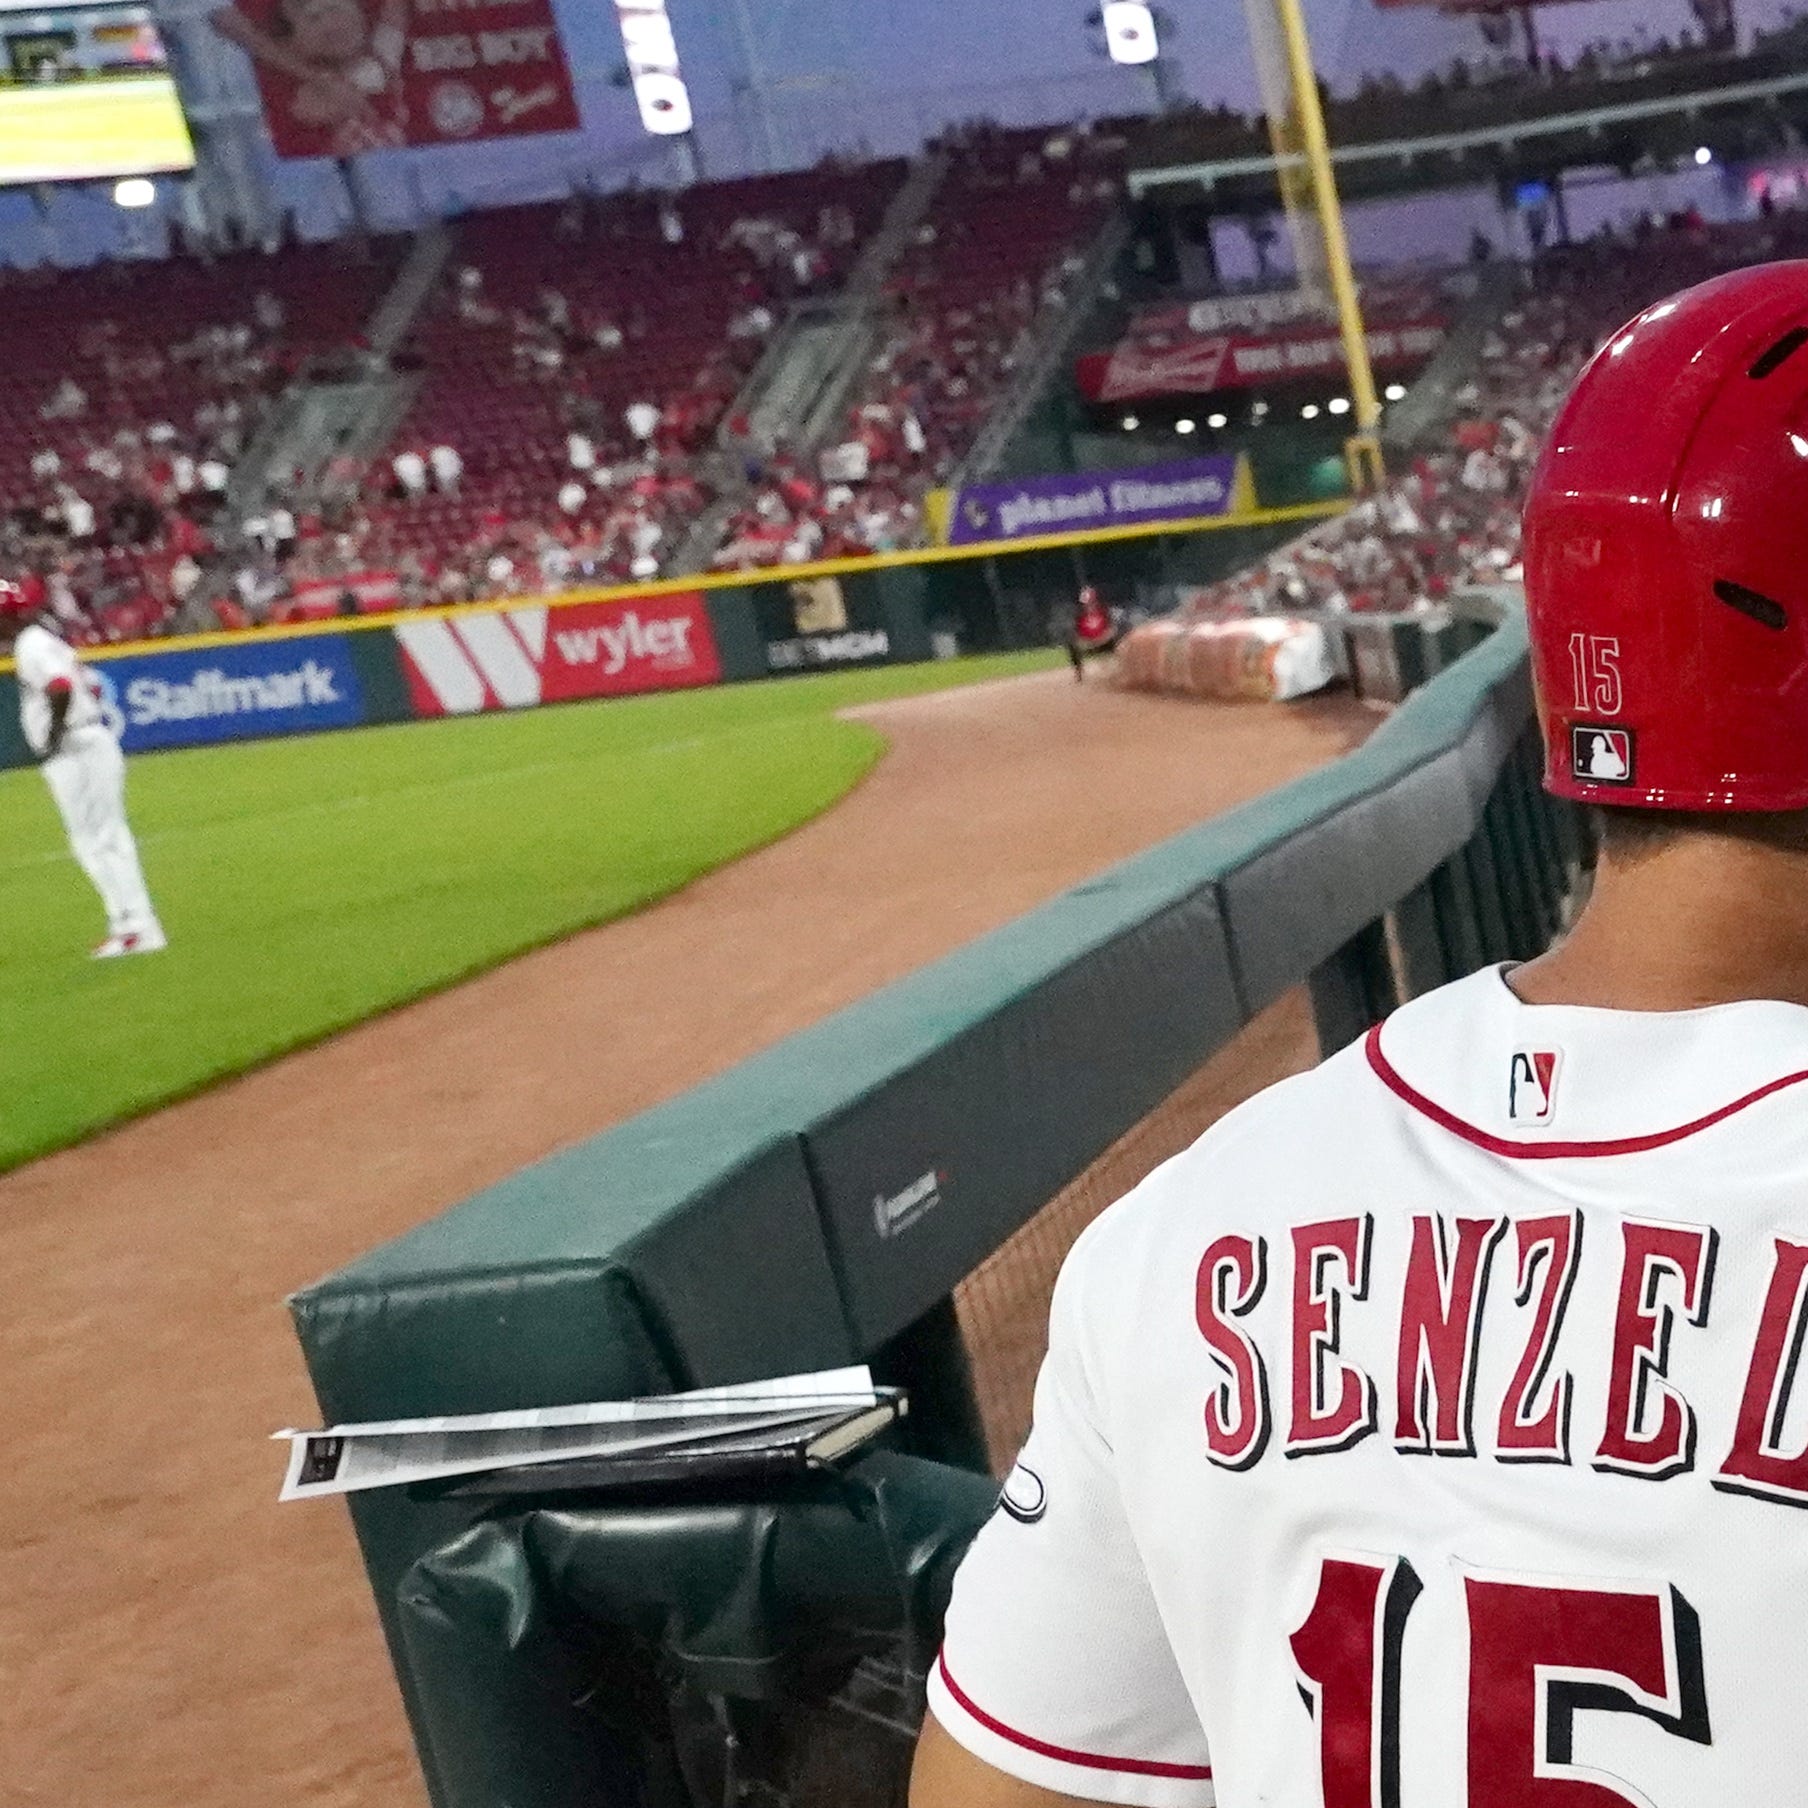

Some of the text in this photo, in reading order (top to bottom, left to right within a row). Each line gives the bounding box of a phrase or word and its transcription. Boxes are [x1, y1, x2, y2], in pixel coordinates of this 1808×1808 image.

[553, 611, 693, 675] wyler
[1568, 633, 1623, 717] 15
[126, 659, 340, 725] Staffmark
